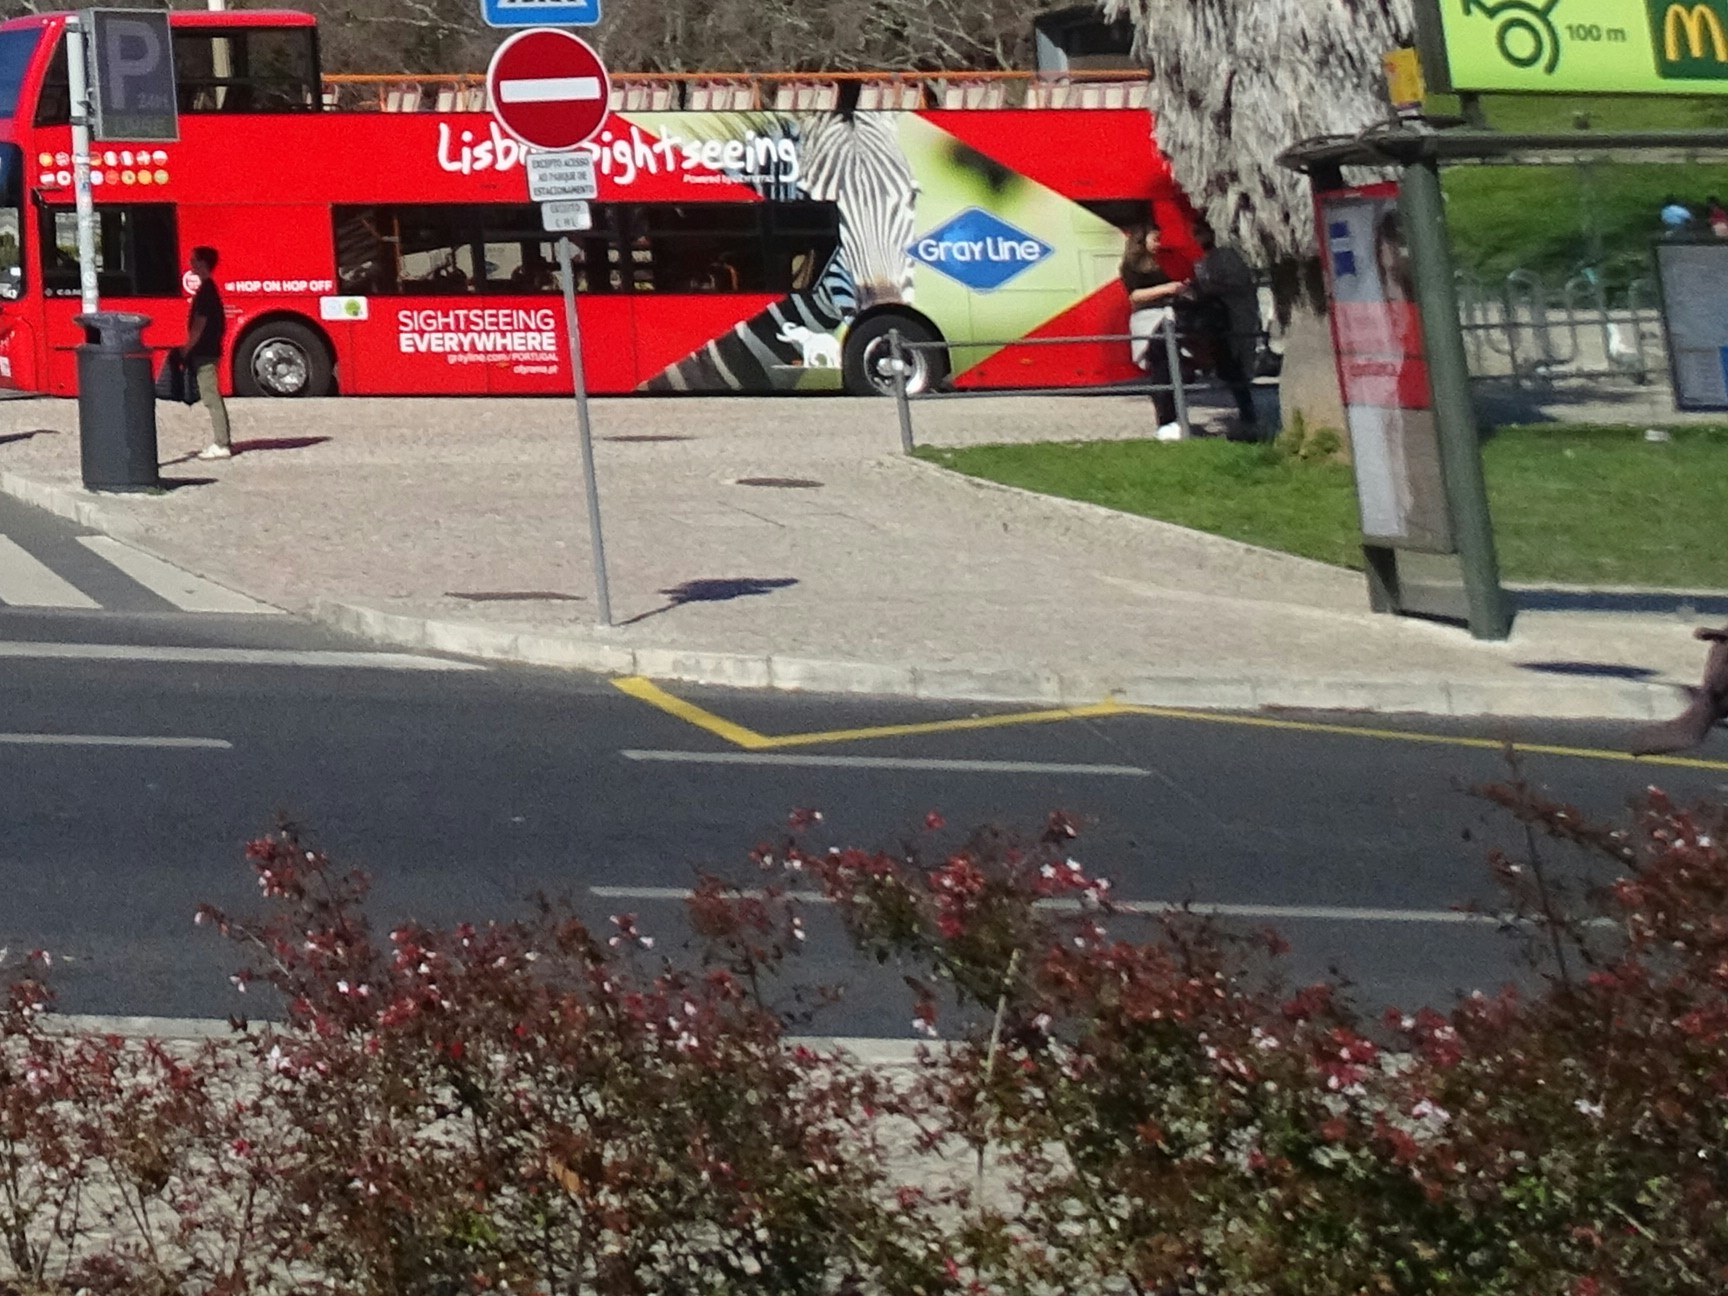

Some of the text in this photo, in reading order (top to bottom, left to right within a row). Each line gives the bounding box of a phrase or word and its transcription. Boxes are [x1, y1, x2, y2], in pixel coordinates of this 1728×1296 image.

[1566, 23, 1626, 43] 100 m
[106, 19, 160, 110] P
[564, 157, 590, 167] ACESSO
[549, 172, 575, 183] PARQUE
[533, 185, 595, 196] ESTACIONAMENTO
[236, 280, 261, 292] HOP
[263, 280, 281, 292] ON
[283, 280, 307, 292] HOP
[309, 280, 332, 292] OFF
[398, 309, 556, 331] SIGHTSEEING
[399, 332, 556, 352] EVERYWHERE
